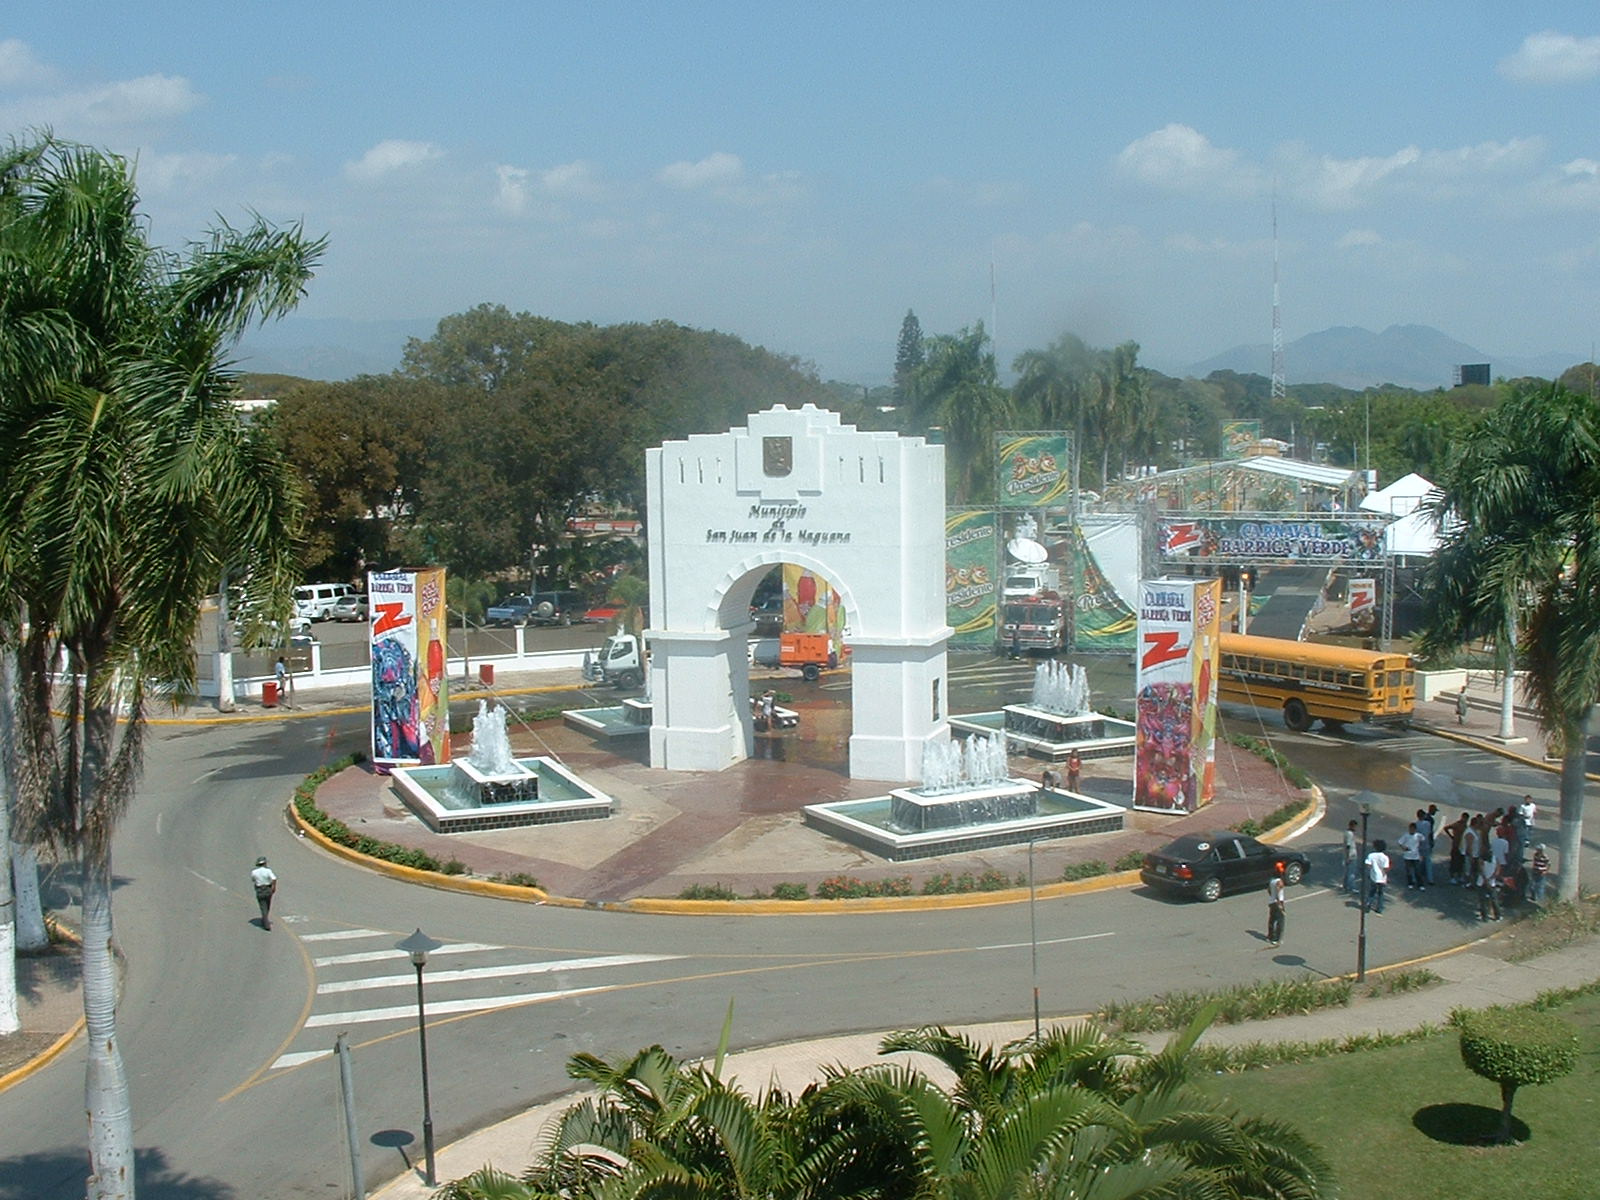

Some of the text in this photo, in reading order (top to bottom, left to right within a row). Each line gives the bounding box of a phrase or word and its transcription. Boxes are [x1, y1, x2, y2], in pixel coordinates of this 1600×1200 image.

[1006, 470, 1061, 497] Presidente
[749, 504, 807, 519] Municipio
[771, 517, 785, 530] de
[1240, 523, 1322, 540] CARNAVAL
[706, 528, 851, 546] San Juan de la Maguana
[945, 526, 993, 552] residente
[1220, 540, 1350, 557] BARRIGA VERDE
[946, 582, 995, 606] residente
[1144, 591, 1185, 607] CARNAVAL
